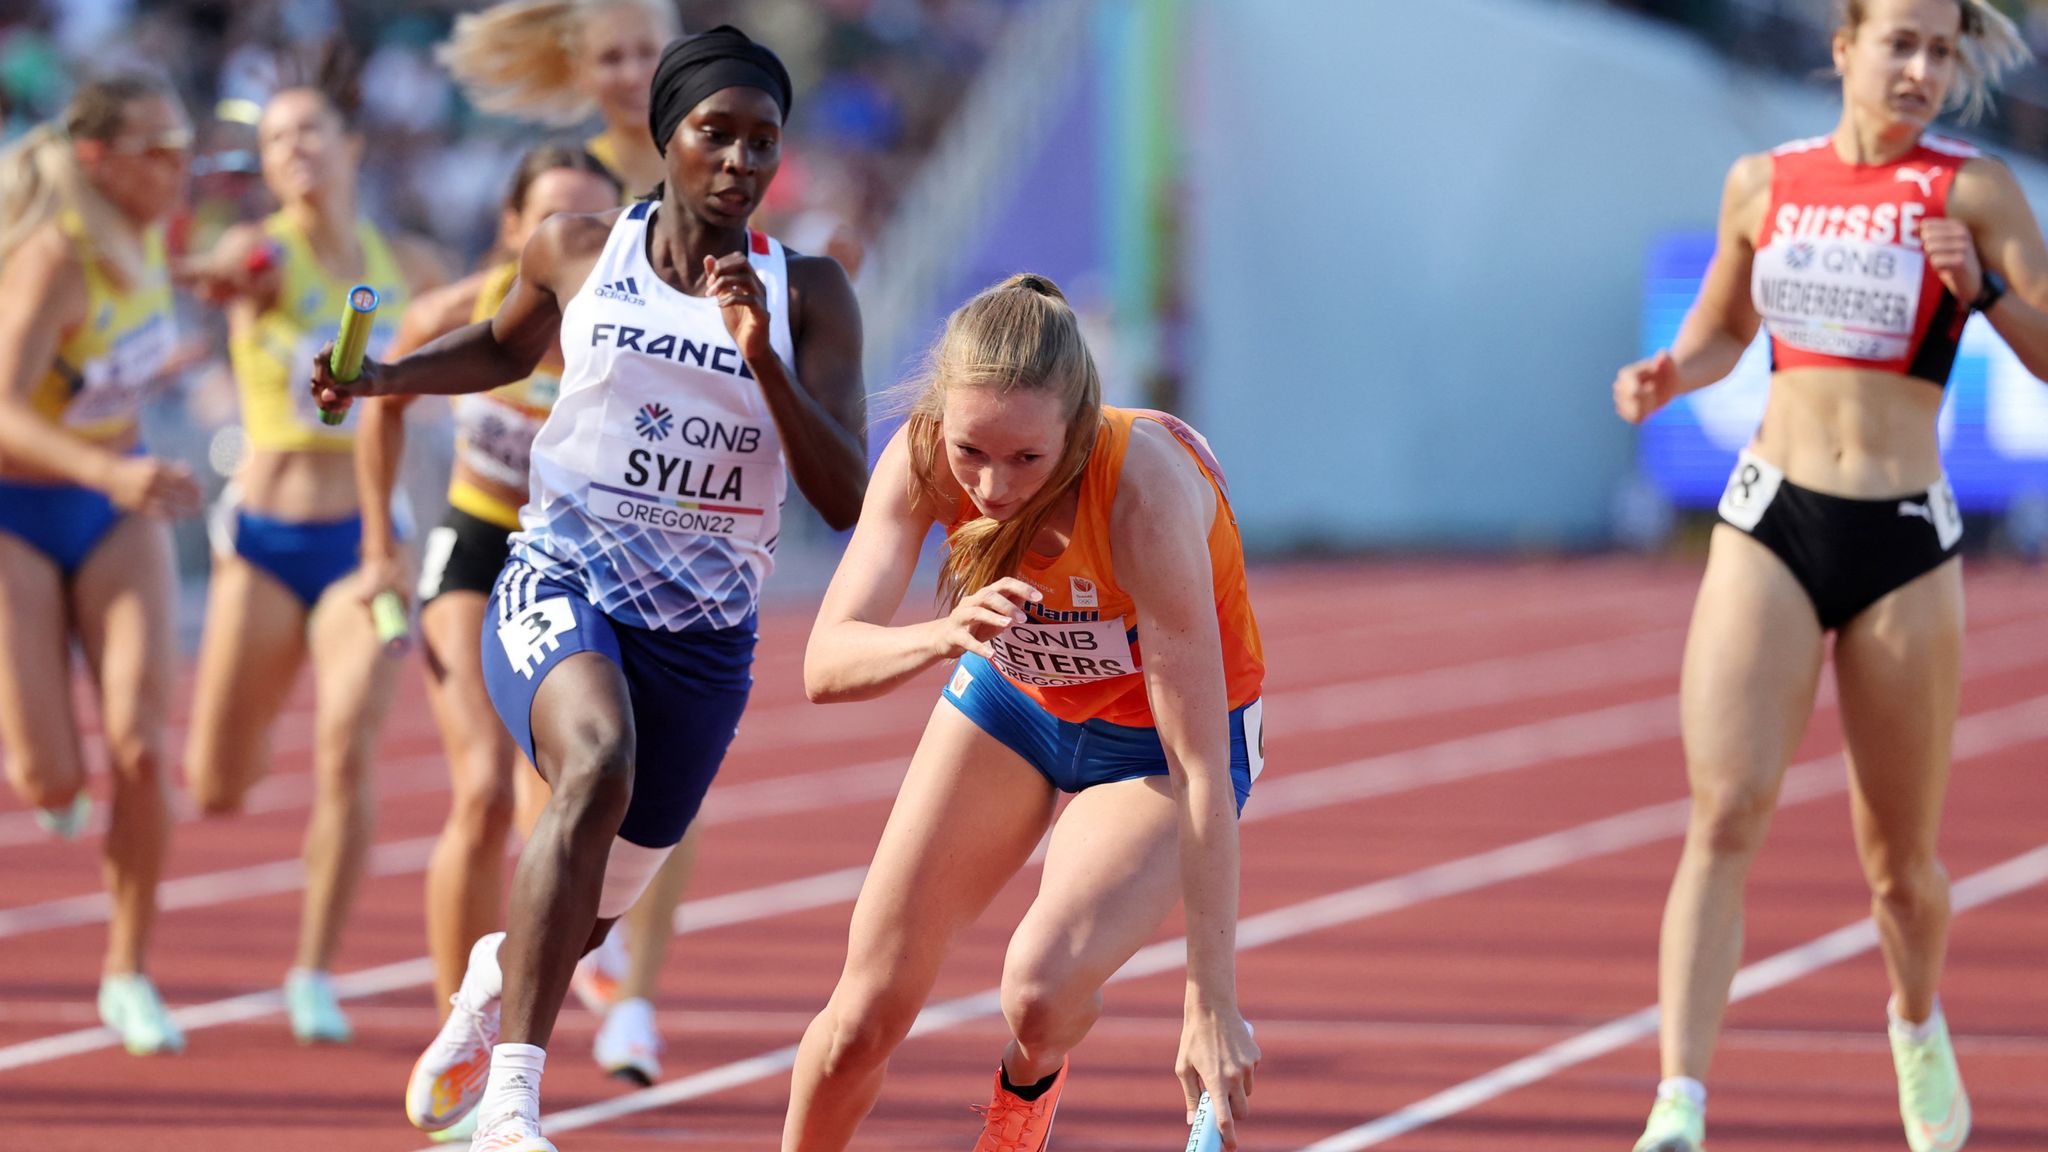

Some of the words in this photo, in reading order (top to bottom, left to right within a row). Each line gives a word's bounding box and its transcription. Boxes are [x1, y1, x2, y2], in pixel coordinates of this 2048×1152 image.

[1822, 243, 1897, 281] QNB
[594, 287, 646, 307] adidas
[1760, 278, 1909, 330] NIEDERBERGER
[681, 416, 762, 454] QNB
[624, 448, 743, 502] SYLLA
[616, 500, 736, 535] OREGON22
[520, 611, 552, 647] 3
[1010, 625, 1099, 651] QNB
[989, 637, 1127, 676] EETERS
[993, 657, 1096, 687] OREGON
